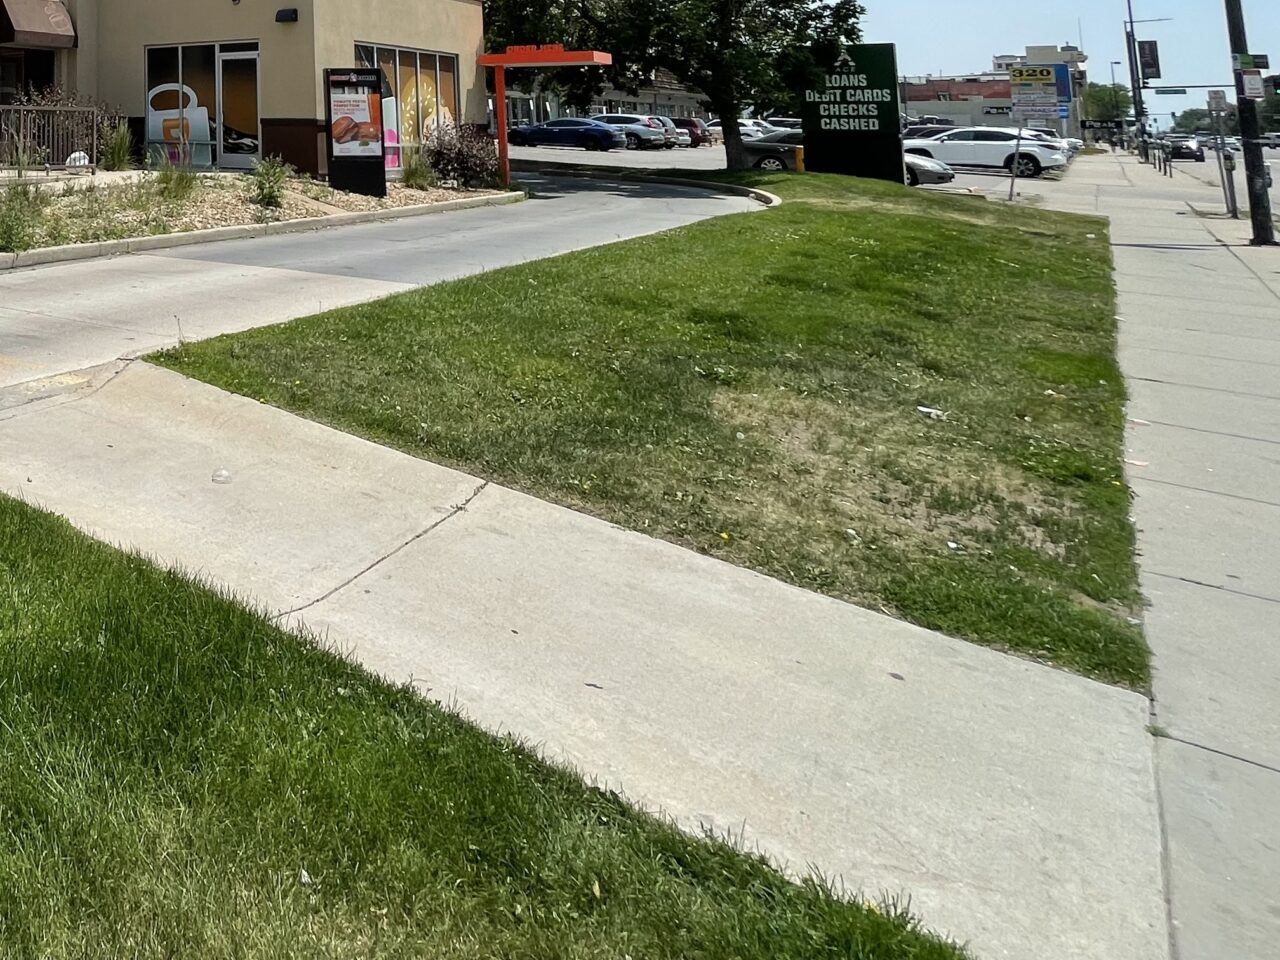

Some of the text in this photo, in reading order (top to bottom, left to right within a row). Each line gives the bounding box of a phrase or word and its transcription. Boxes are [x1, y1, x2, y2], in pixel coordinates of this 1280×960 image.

[1012, 68, 1051, 78] 320
[825, 74, 867, 87] LOANS
[846, 89, 891, 102] CARDS
[820, 104, 878, 116] CHECKS
[821, 118, 879, 130] CASHED
